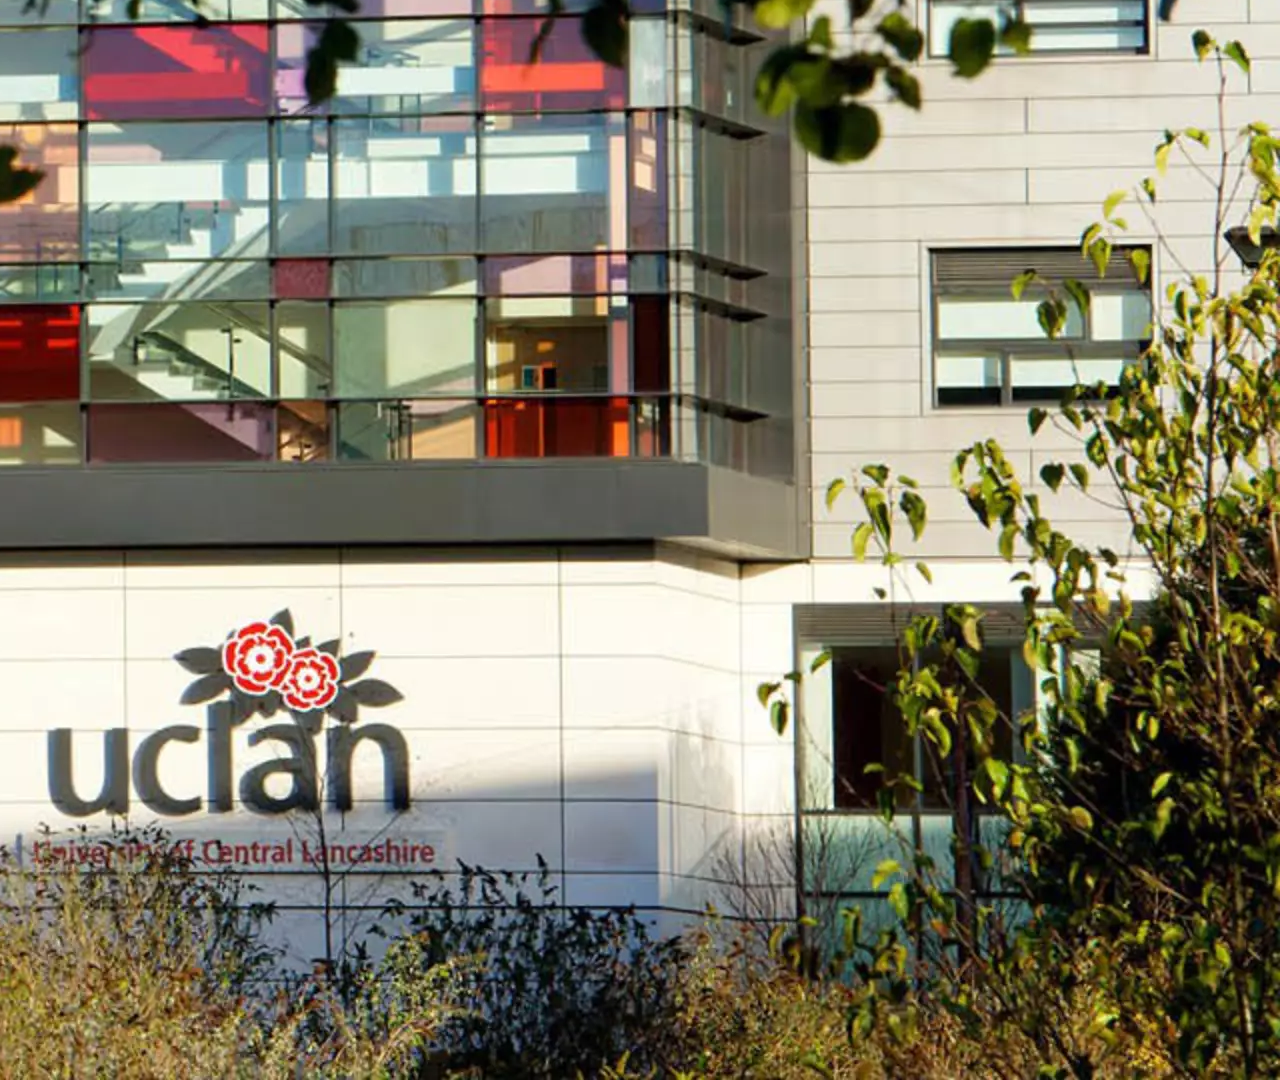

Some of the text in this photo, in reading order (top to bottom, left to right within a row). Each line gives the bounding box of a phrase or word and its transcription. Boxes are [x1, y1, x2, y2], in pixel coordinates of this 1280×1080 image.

[46, 701, 411, 817] uclan
[32, 840, 167, 869] Univeit
[202, 838, 293, 864] Central
[301, 838, 435, 864] Lancashire
